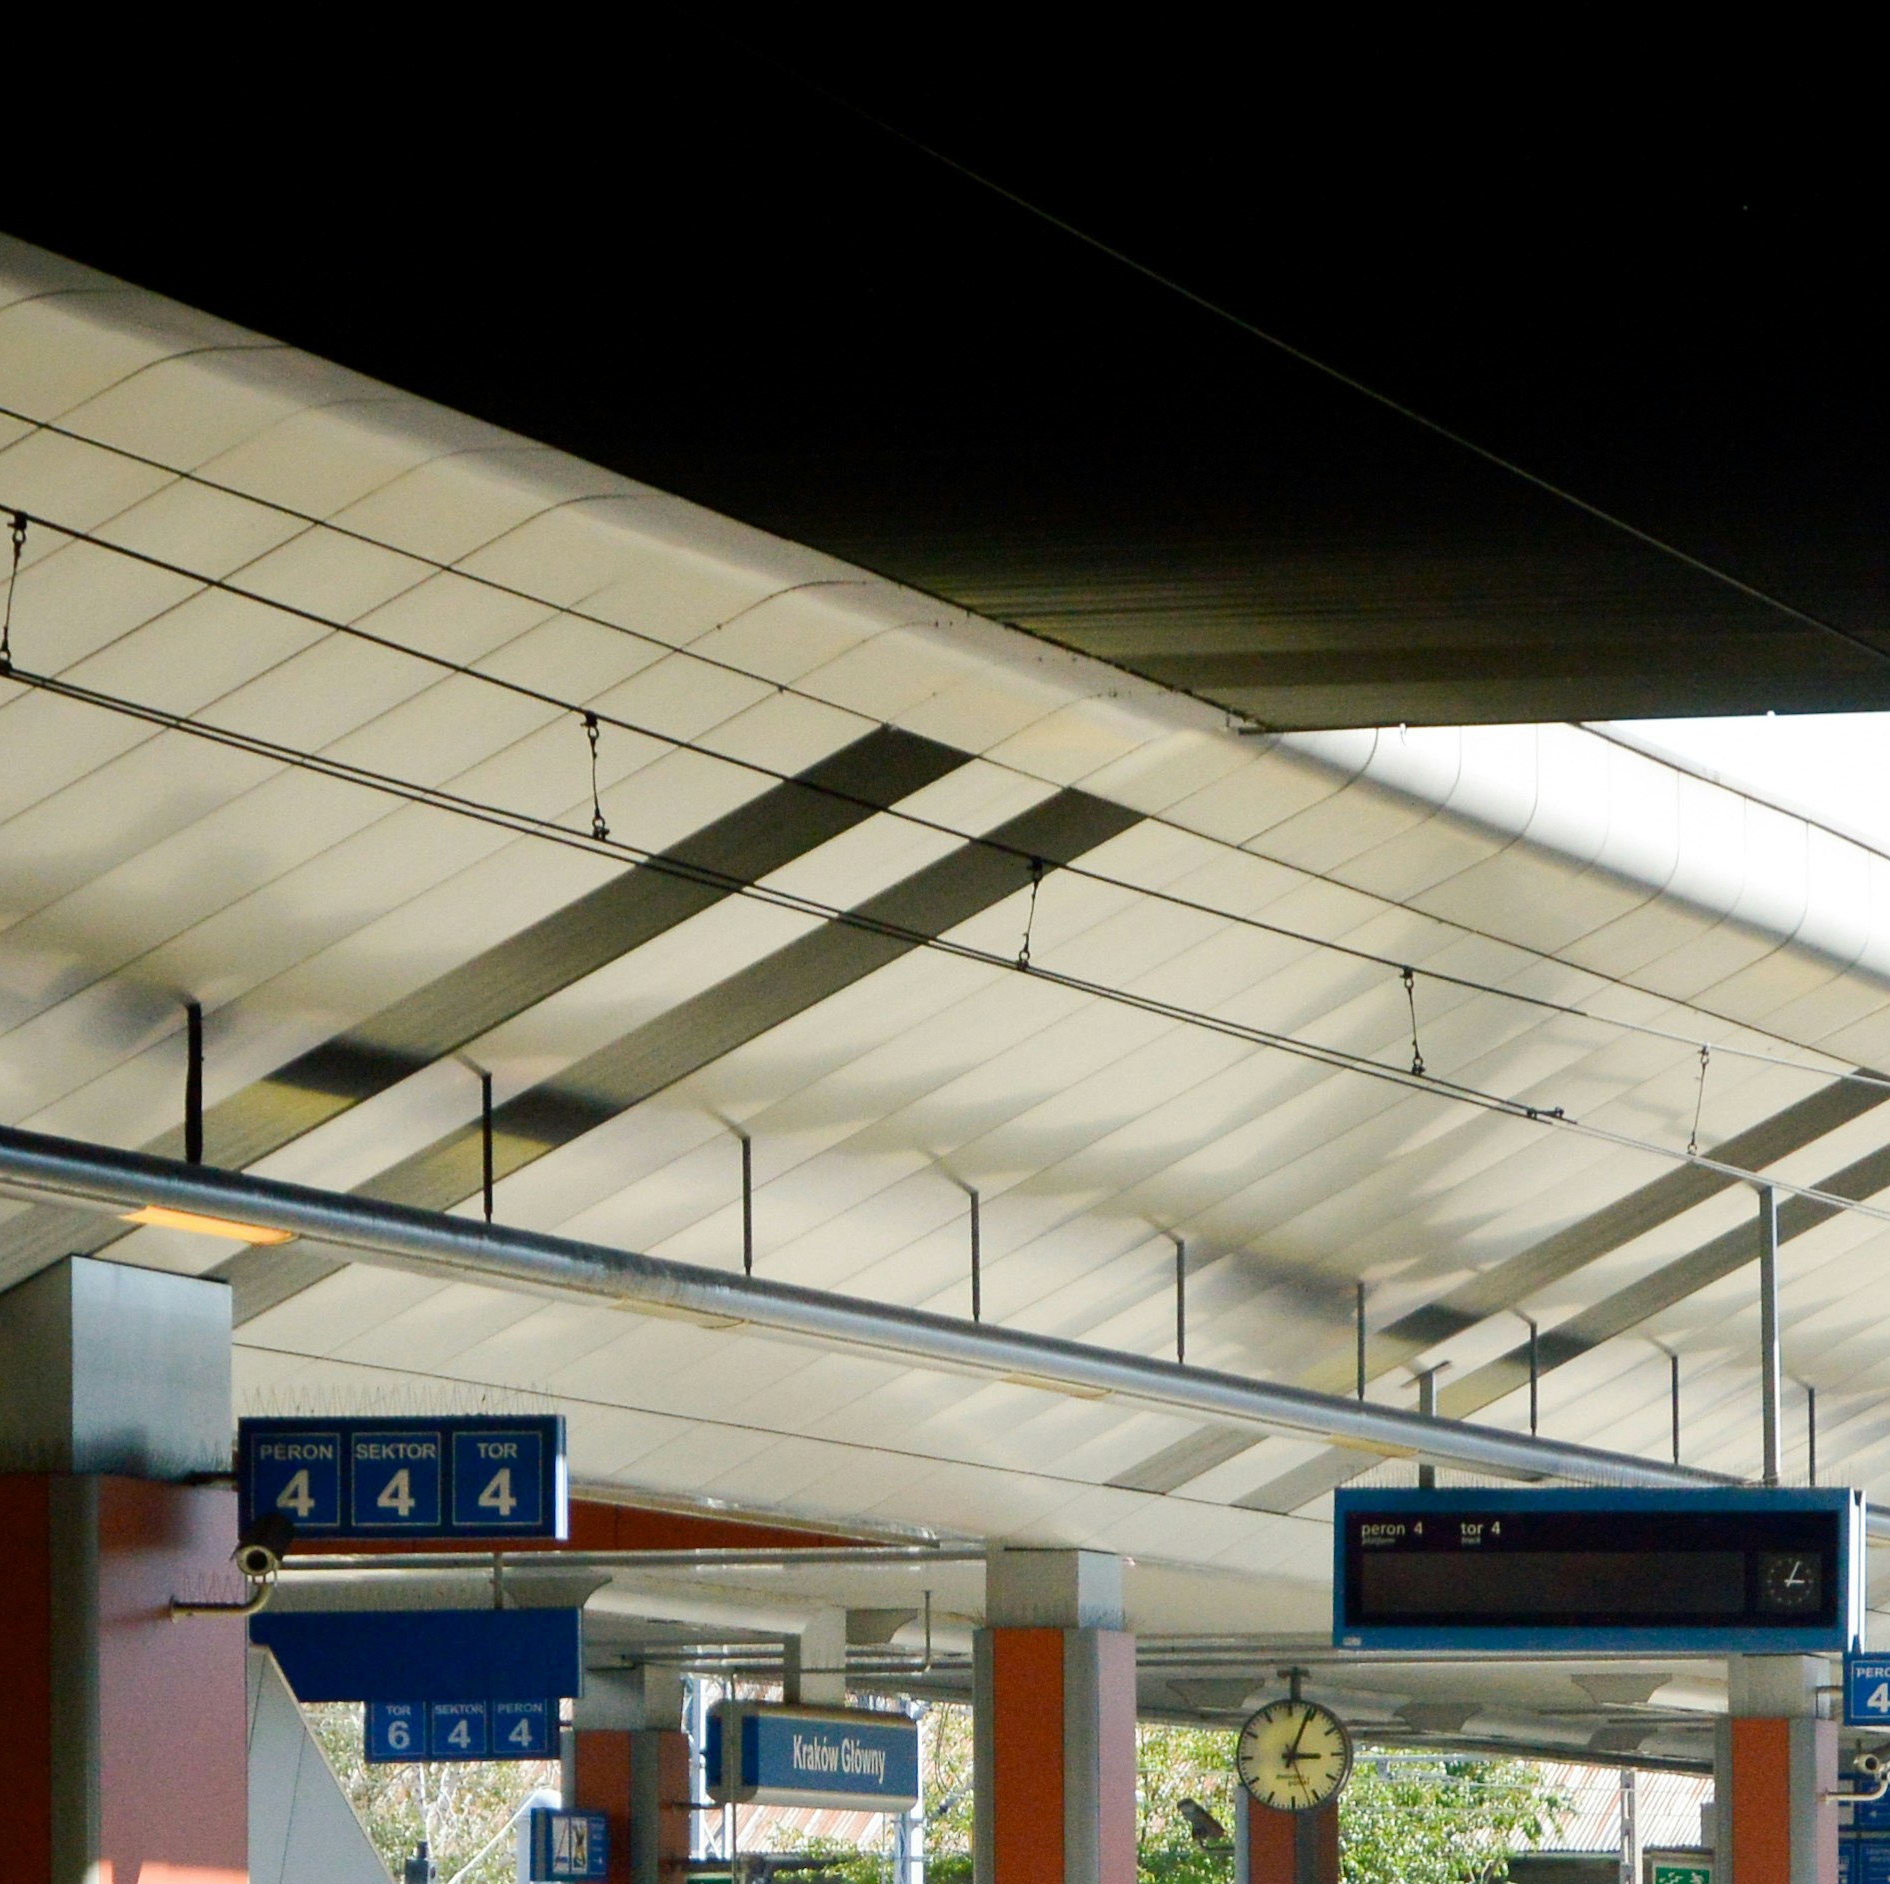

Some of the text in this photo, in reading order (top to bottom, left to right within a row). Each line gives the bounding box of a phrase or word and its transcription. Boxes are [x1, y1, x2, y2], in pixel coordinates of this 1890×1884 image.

[260, 1443, 518, 1460] PERON SEKTOR TOR
[276, 1467, 517, 1517] 4 4 4
[1361, 1521, 1501, 1537] peron 4 tor 4
[385, 1702, 543, 1716] TOR SEKTOR PERON
[387, 1718, 533, 1750] 6 4 4
[793, 1734, 886, 1784] Kraków Główny
